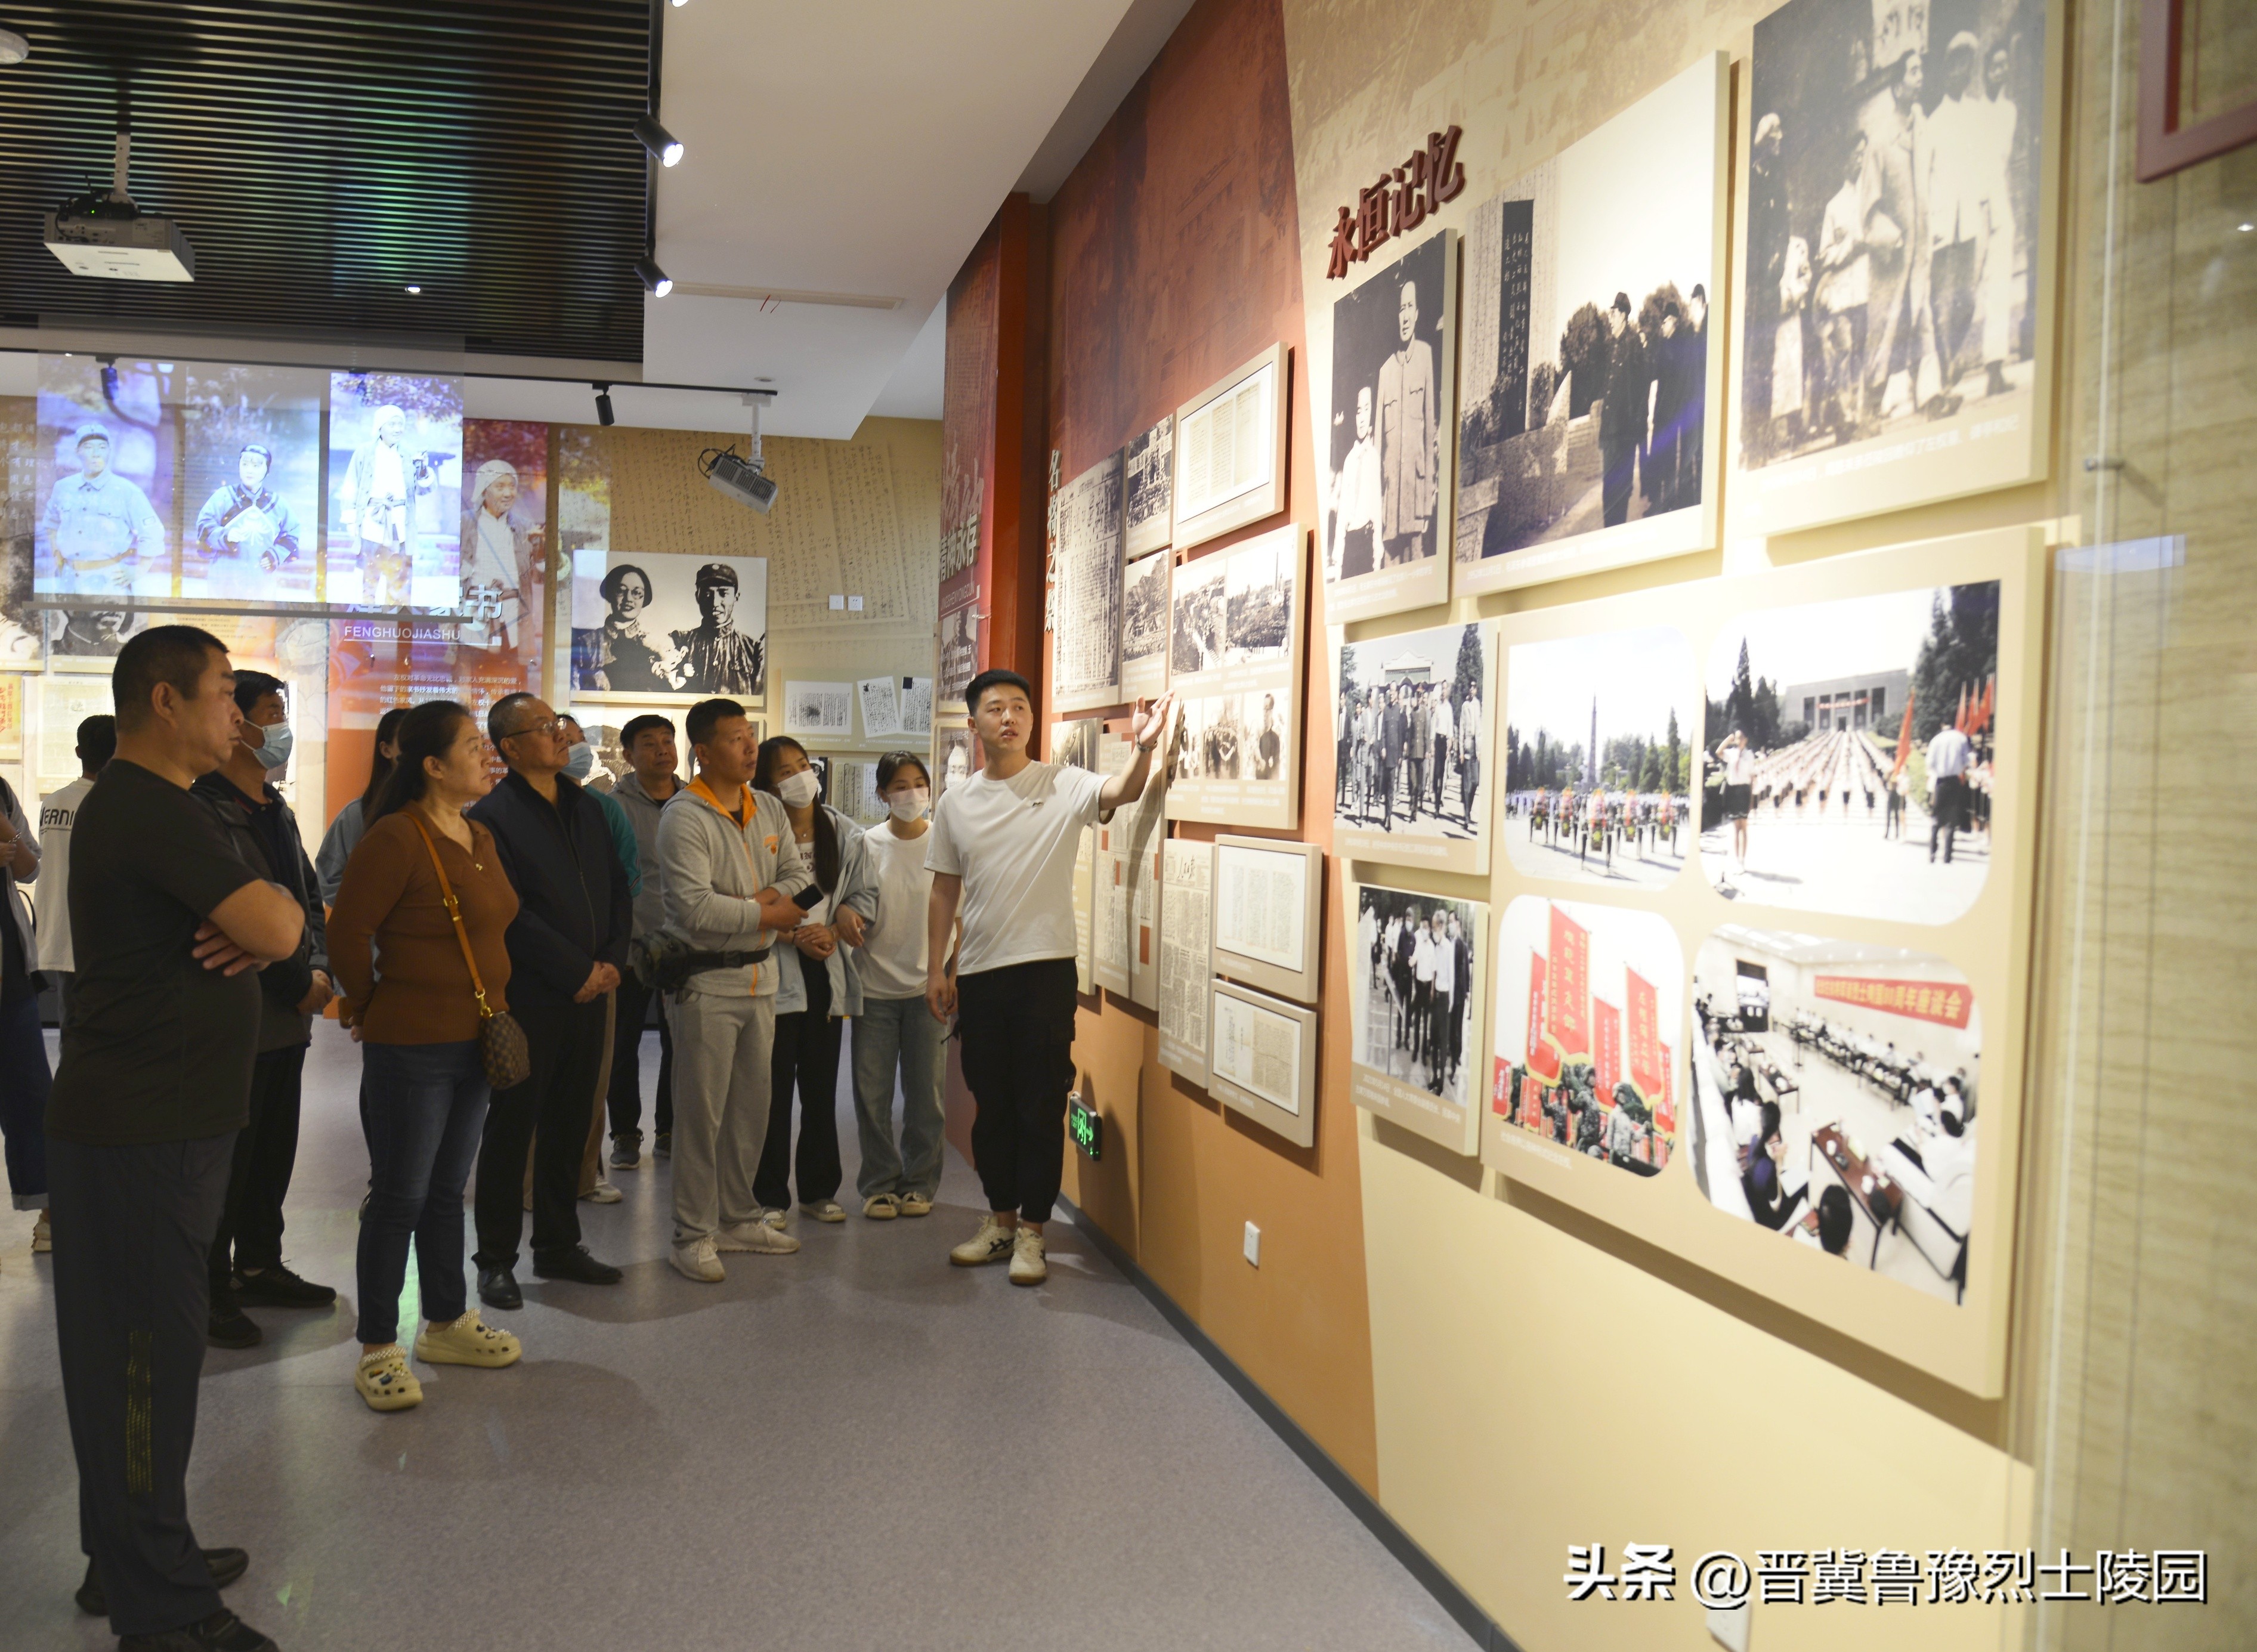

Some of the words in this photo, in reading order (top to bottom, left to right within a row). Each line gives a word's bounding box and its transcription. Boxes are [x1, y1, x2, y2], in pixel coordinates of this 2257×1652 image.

[1326, 125, 1467, 280] 永恒记忆
[345, 626, 460, 640] FENGHUOJIASHU
